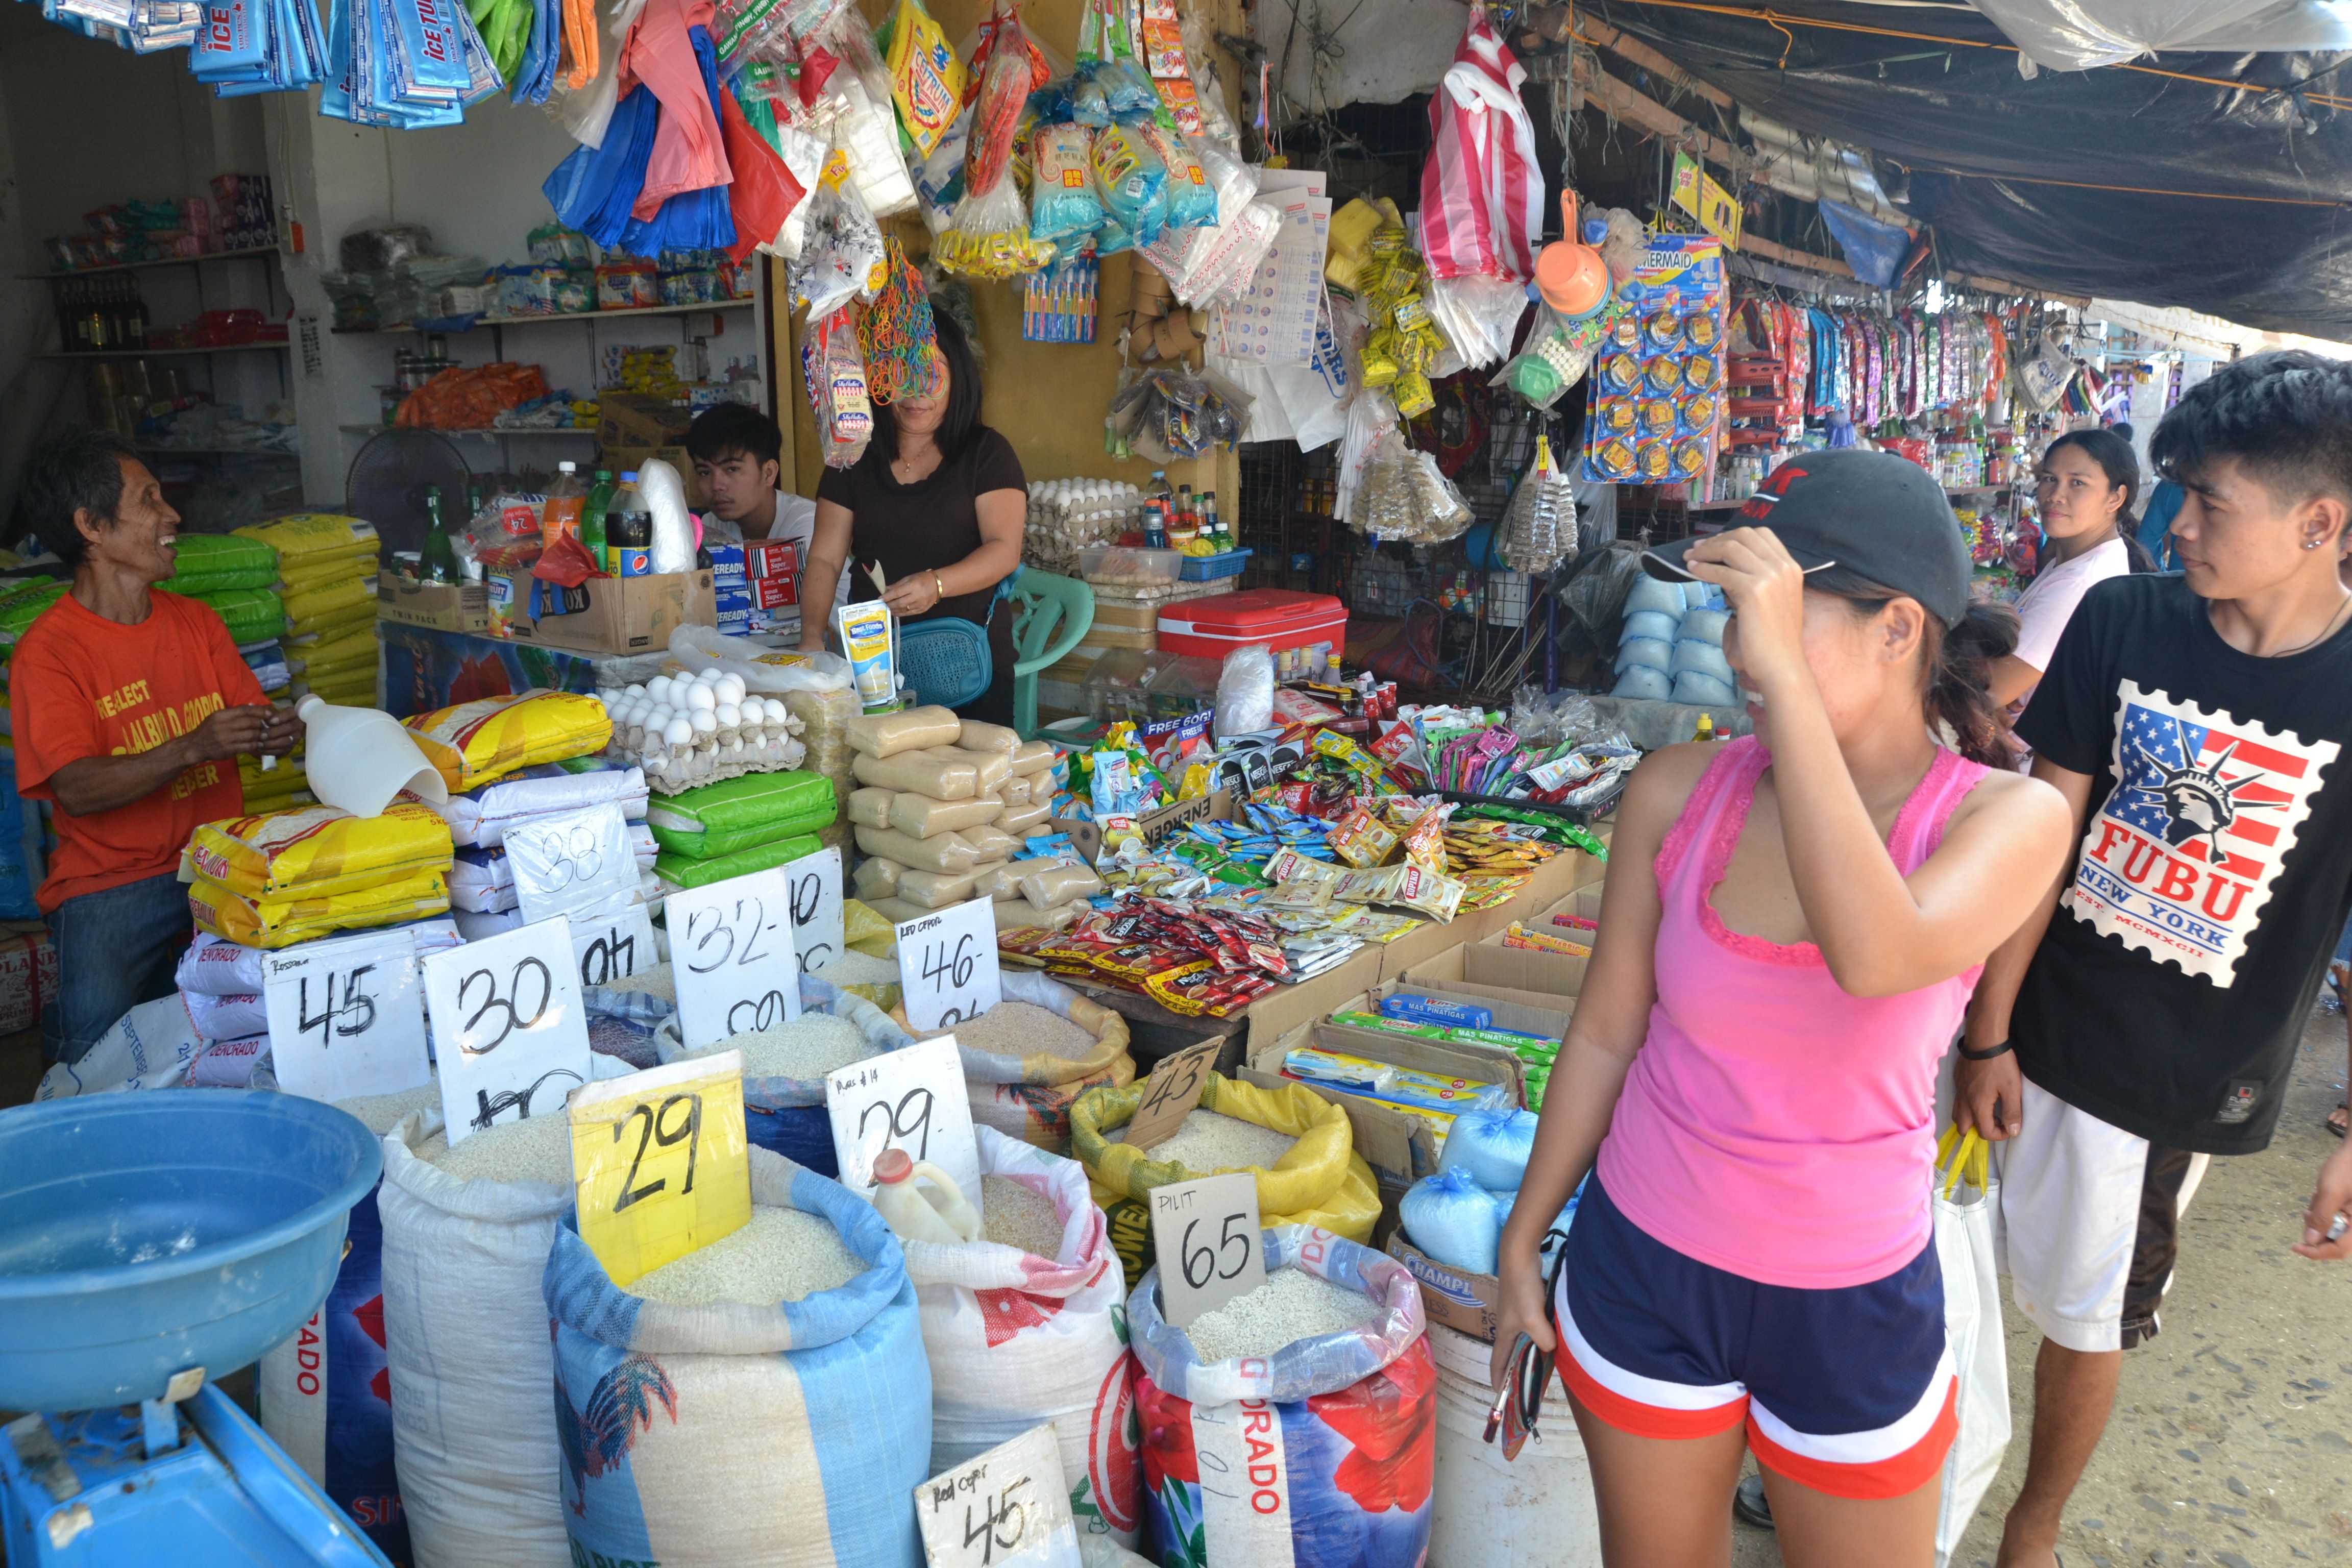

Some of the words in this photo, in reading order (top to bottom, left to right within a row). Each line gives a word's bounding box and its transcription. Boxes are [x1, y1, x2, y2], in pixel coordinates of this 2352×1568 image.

[511, 518, 528, 530] 24
[771, 561, 786, 570] Super
[416, 614, 437, 625] PACK
[851, 625, 865, 635] Best
[1148, 719, 1181, 735] FREE
[2089, 818, 2253, 922] FUBU
[1407, 870, 1418, 897] KOPIKO
[2078, 864, 2132, 904] NEW
[2148, 901, 2229, 949] YORK
[2075, 888, 2104, 914] EST.
[2114, 914, 2204, 959] MCMXCII
[1554, 940, 1580, 952] FABRIC
[1408, 1002, 1424, 1012] MAS
[1427, 1005, 1466, 1019] PINATIGAS
[1380, 1019, 1425, 1031] WINGS
[1458, 1029, 1476, 1037] MAS
[1479, 1032, 1523, 1044] PINATIGAS
[1142, 1054, 1205, 1117] 43
[612, 1092, 703, 1213] 29
[1158, 1191, 1196, 1214] PILIT
[1182, 1213, 1251, 1289] 65
